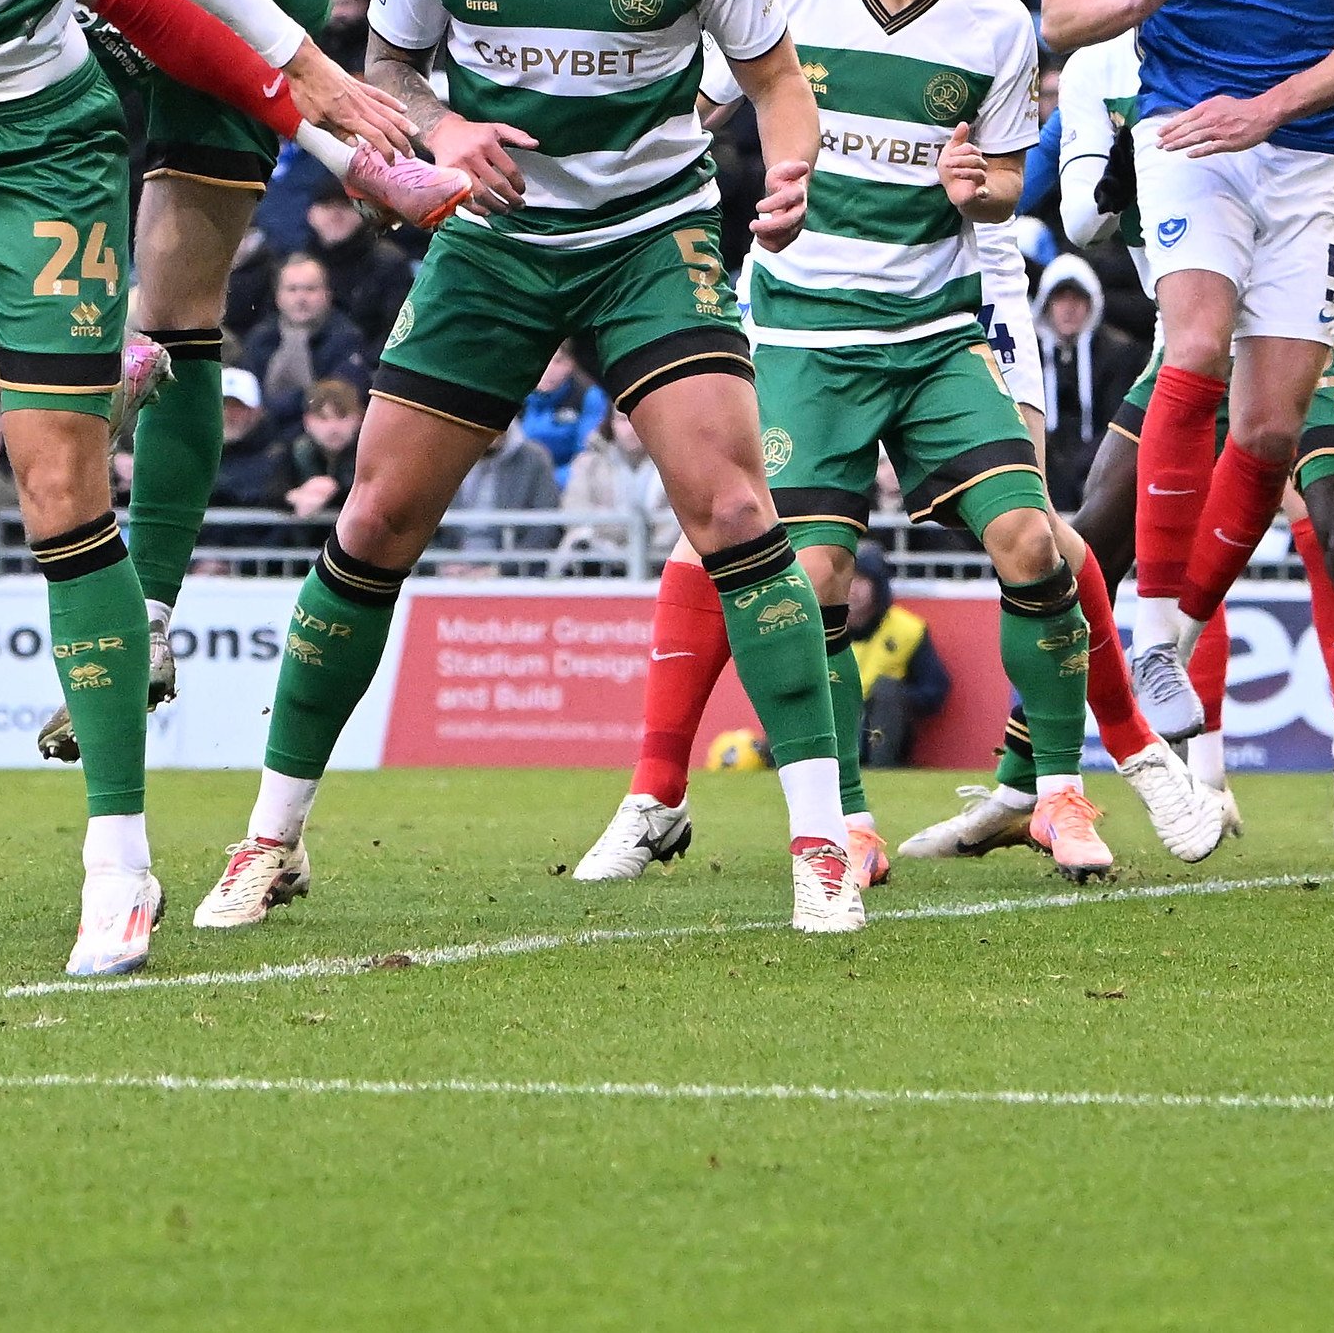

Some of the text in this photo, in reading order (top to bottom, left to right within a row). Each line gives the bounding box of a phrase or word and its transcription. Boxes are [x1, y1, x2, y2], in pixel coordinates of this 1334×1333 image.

[466, 0, 498, 11] errea
[820, 129, 947, 166] PYBET
[33, 221, 119, 296] 24
[673, 229, 721, 286] 5
[696, 303, 724, 318] errea
[70, 326, 103, 338] errea
[54, 637, 127, 658] QPR
[1037, 628, 1088, 651] QP
[436, 648, 549, 677] Stadium
[436, 682, 563, 710] and Build
